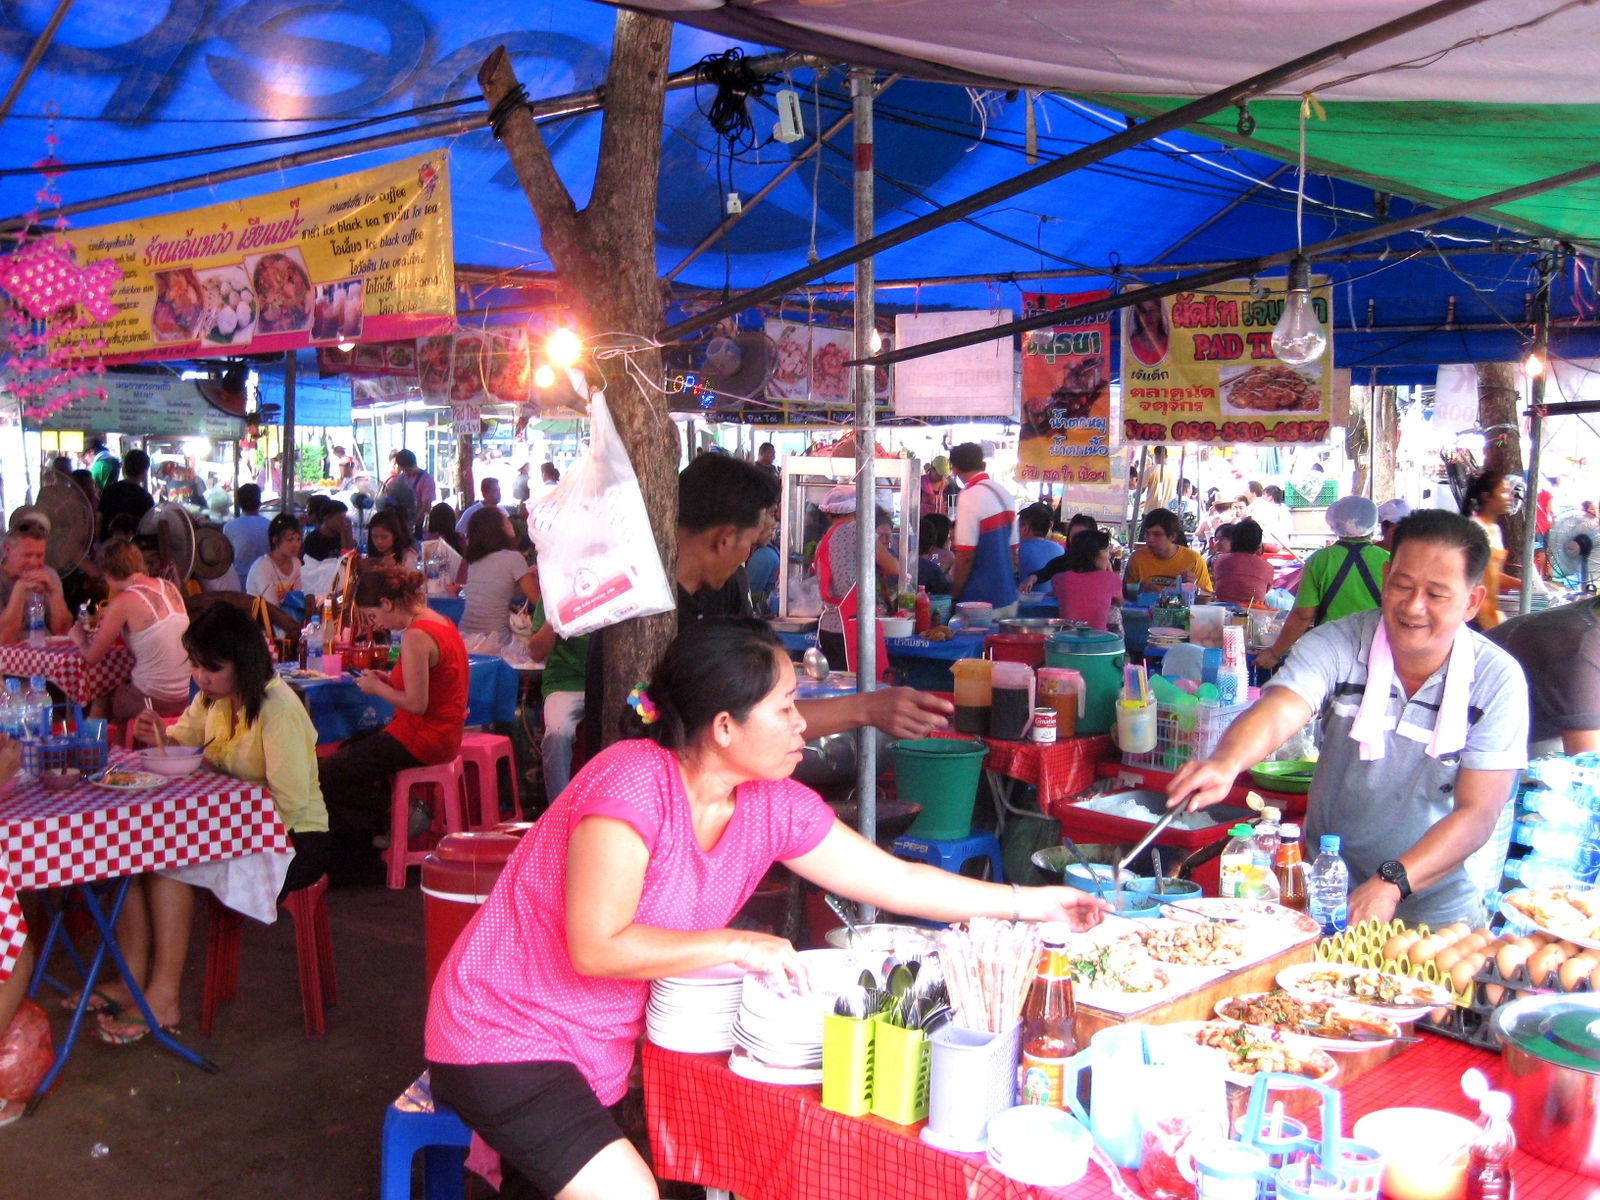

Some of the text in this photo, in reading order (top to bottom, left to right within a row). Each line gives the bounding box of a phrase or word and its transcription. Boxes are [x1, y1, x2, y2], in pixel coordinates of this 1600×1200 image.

[379, 186, 406, 204] coffee
[337, 217, 363, 233] black
[365, 217, 379, 227] tea
[424, 204, 438, 215] tea
[379, 232, 400, 248] black
[402, 227, 425, 246] coffee
[379, 258, 391, 270] Ice
[1172, 293, 1238, 328] ผัดไท
[1193, 332, 1244, 361] PAD
[1130, 384, 1216, 401] ตลาดนัด
[1139, 399, 1204, 416] จตุจักร
[902, 841, 929, 853] PEPSI
